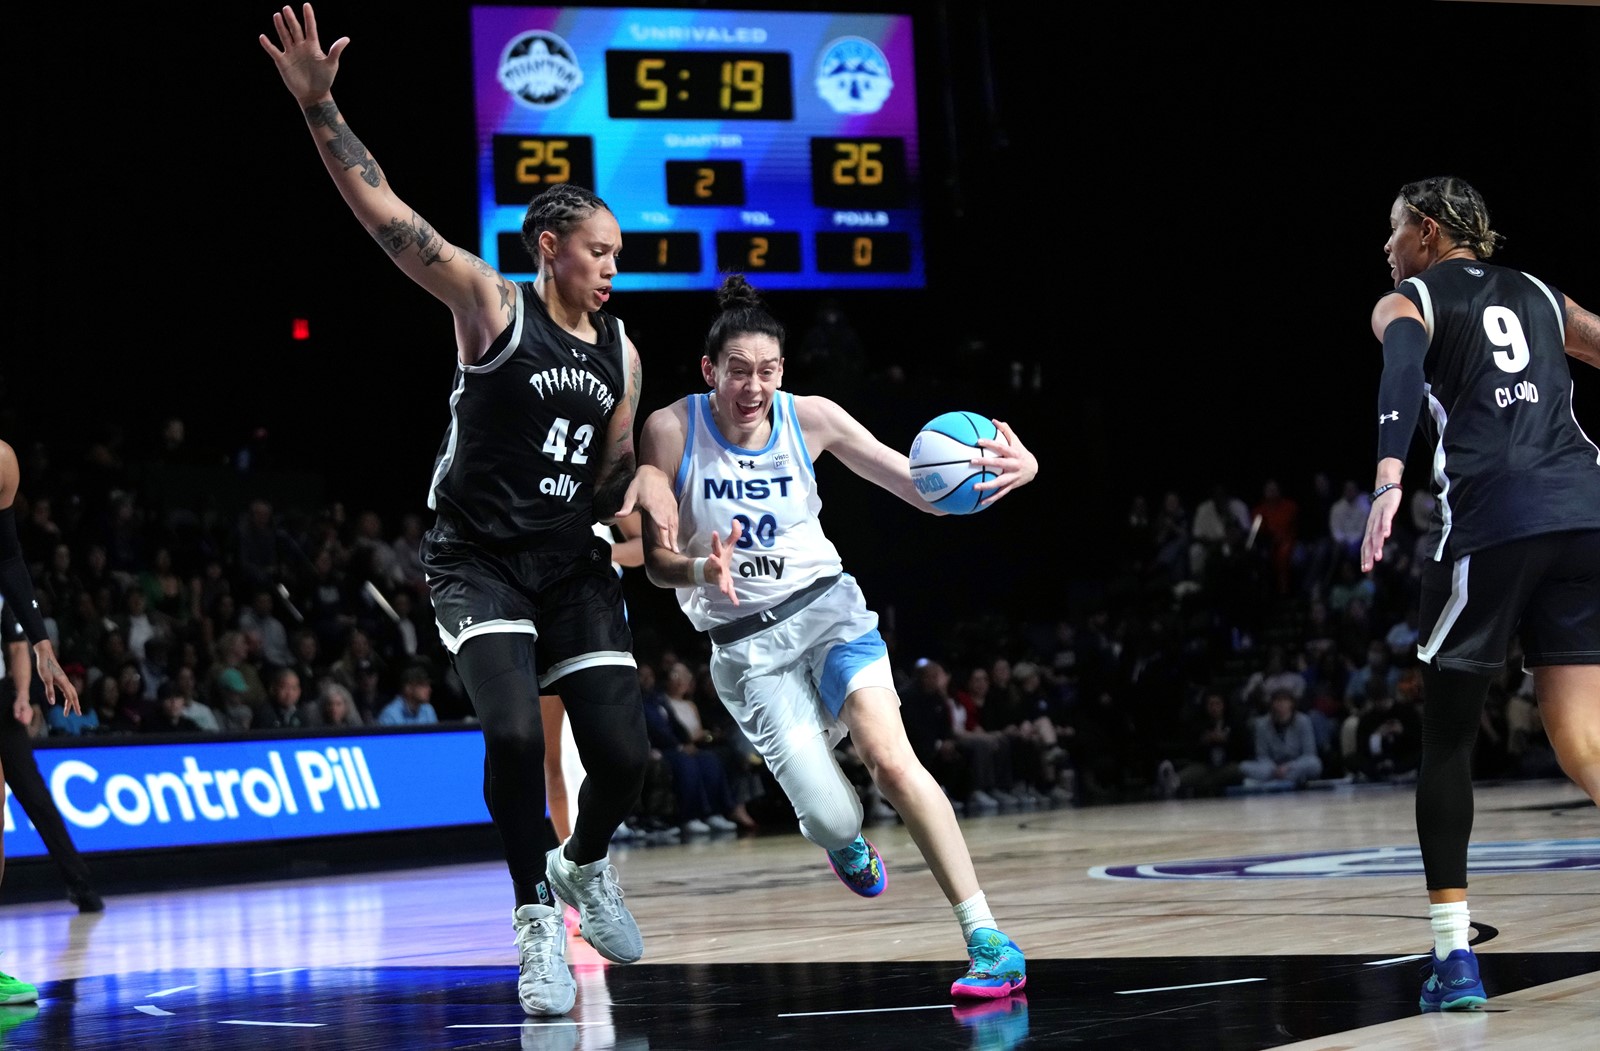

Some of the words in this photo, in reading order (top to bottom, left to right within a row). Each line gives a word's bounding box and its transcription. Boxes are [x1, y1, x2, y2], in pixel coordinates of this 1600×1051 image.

[629, 24, 767, 43] UNRIVALED
[516, 140, 570, 184] 25
[833, 143, 883, 186] 26
[695, 168, 715, 197] 2
[658, 239, 668, 265] 1
[750, 237, 768, 267] 2
[854, 237, 872, 266] 0
[1483, 305, 1530, 373] 9
[529, 366, 615, 416] PHANTOM
[542, 417, 595, 465] 42
[539, 474, 582, 502] ally
[704, 476, 793, 500] MIST
[739, 556, 785, 580] ally
[50, 751, 298, 828] Control
[296, 747, 381, 813] Pill
